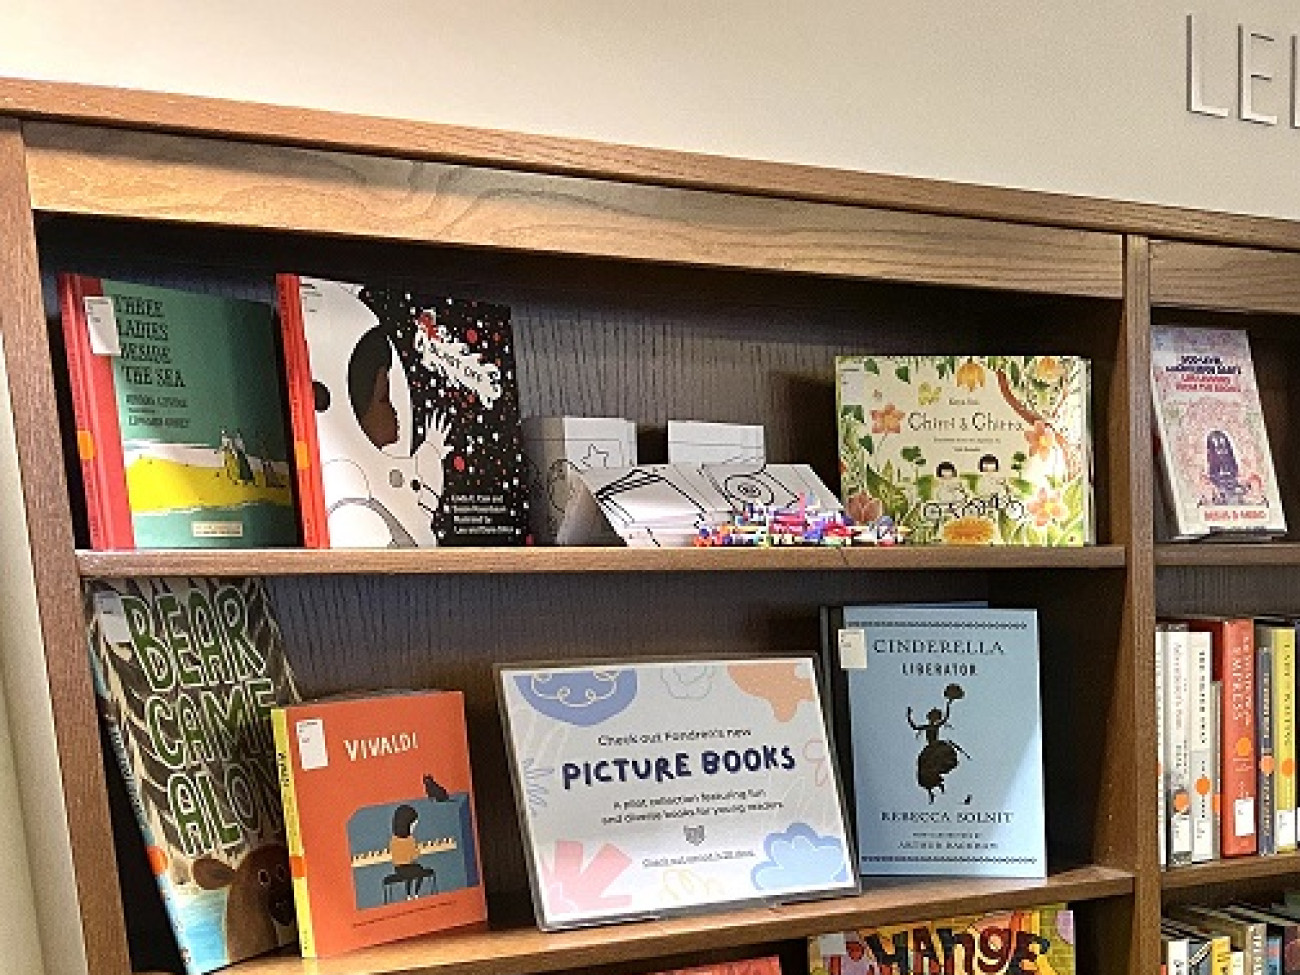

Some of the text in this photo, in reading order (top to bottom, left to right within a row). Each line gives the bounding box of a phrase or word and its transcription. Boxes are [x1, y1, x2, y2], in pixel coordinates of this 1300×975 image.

[121, 366, 187, 388] THE SEA
[959, 417, 969, 431] &
[123, 586, 266, 692] BEAR
[873, 639, 1006, 656] CINDERELLA
[902, 663, 978, 677] LIBERATOR
[147, 679, 274, 770] CAME
[342, 732, 420, 762] VIVALDI
[598, 731, 637, 747] Check
[640, 732, 663, 745] out
[727, 728, 752, 738] new
[562, 744, 796, 790] PICTURE BOOKS
[613, 801, 622, 811] A
[602, 814, 623, 826] and
